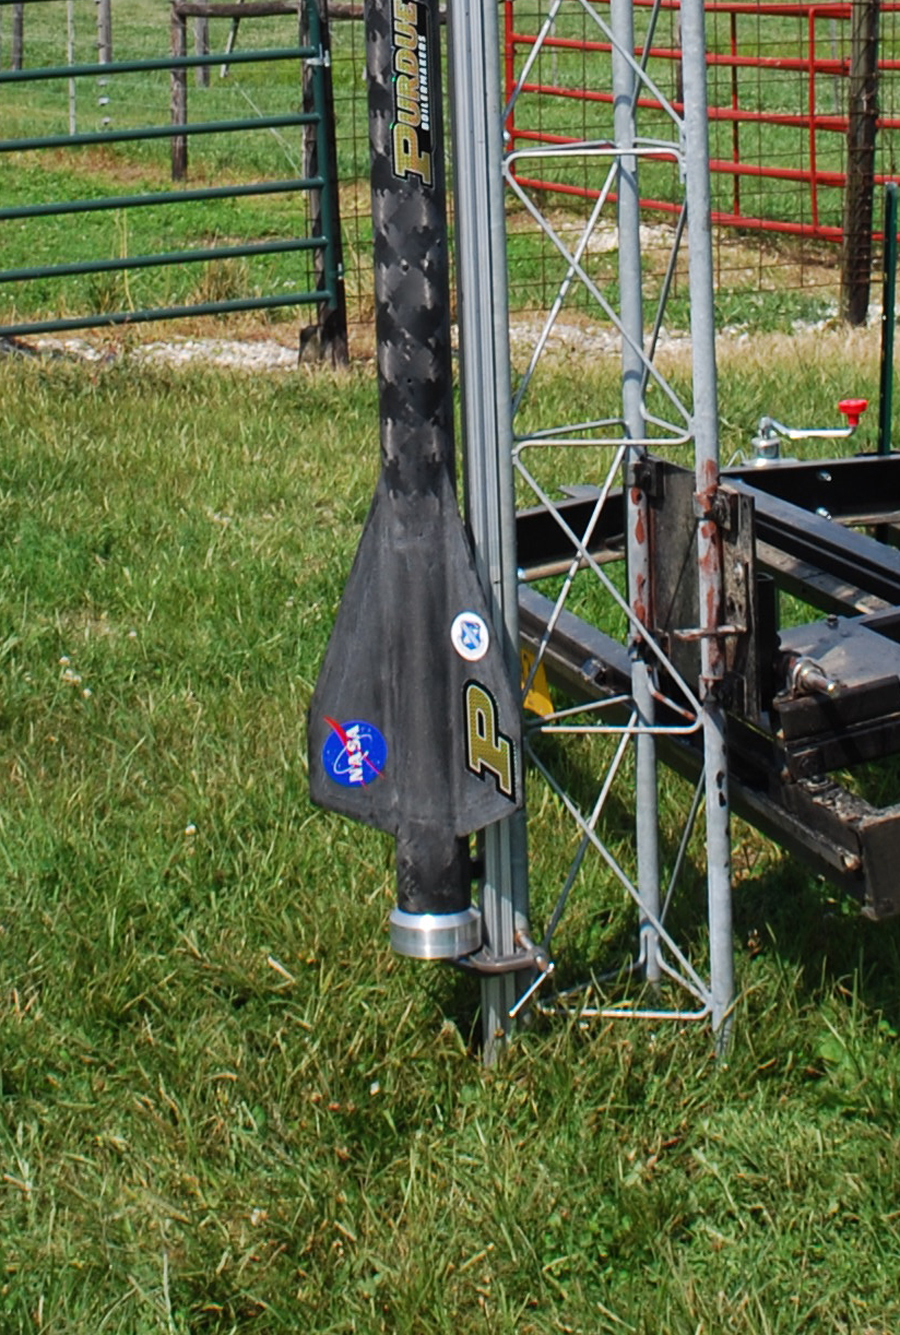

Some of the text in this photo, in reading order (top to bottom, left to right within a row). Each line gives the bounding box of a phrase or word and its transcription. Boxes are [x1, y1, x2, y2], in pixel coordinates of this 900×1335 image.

[418, 35, 430, 131] BOILERMAKERS
[346, 725, 363, 783] NASA
[466, 684, 512, 795] P
